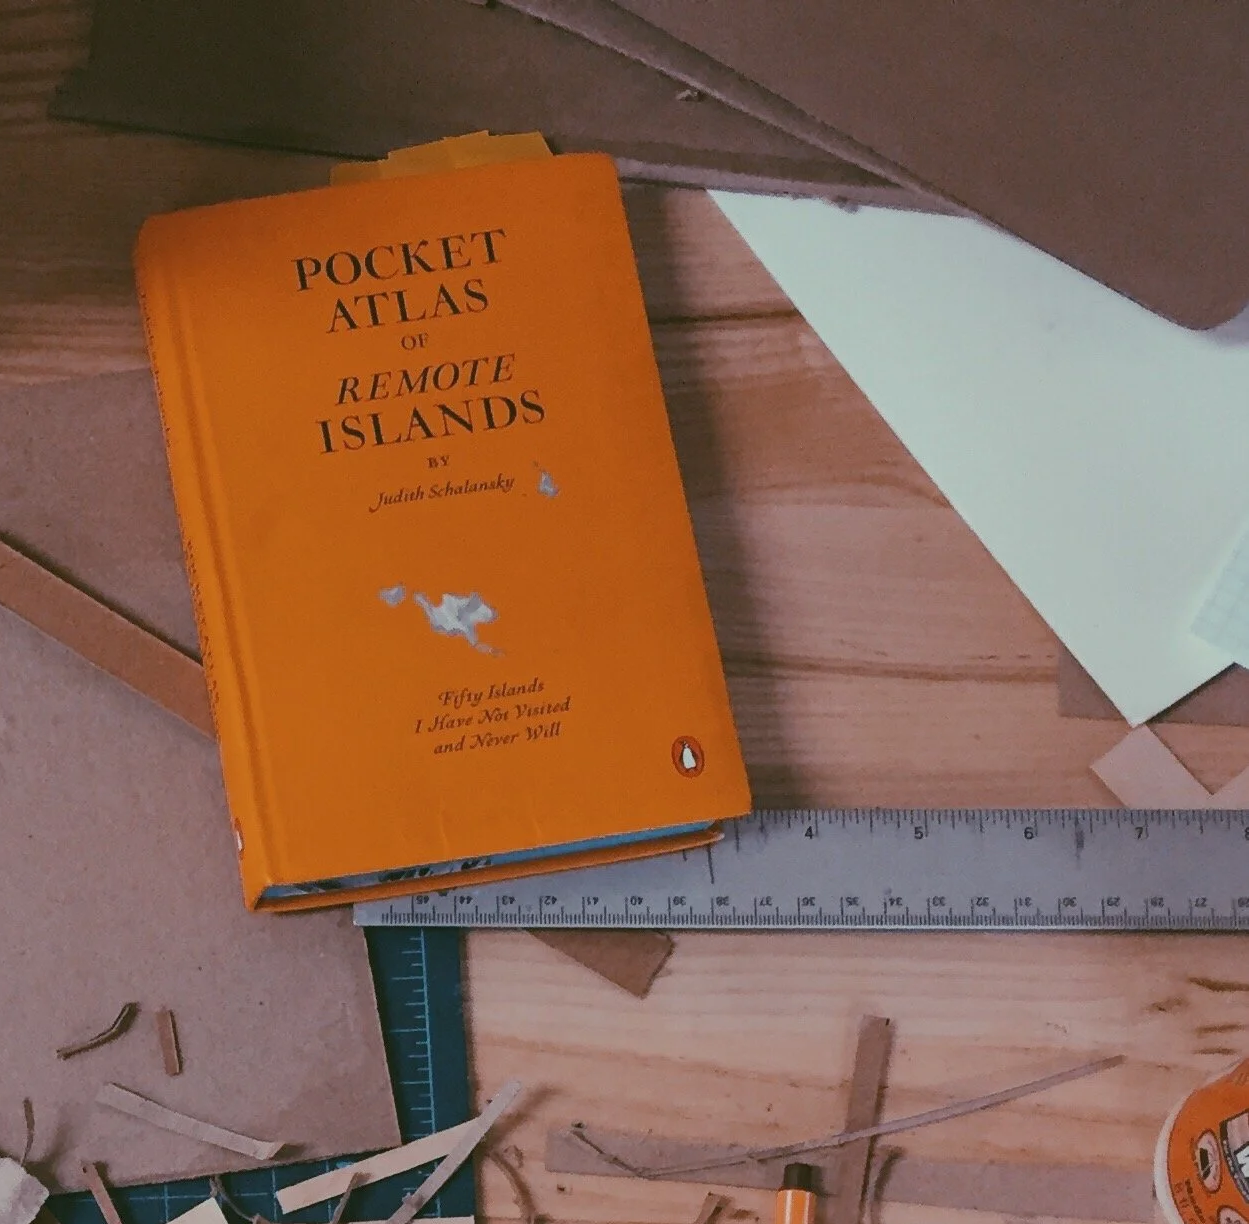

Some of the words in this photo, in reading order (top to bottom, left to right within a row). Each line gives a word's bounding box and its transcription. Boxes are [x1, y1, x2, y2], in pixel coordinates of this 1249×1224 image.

[291, 229, 507, 292] POCKET
[326, 278, 488, 333] ATLAS
[401, 333, 428, 350] OF
[334, 353, 515, 406] REMOTE
[315, 389, 545, 455] ISLANDS
[427, 455, 450, 469] BY
[368, 485, 424, 513] Judith
[428, 473, 515, 500] Schalansky
[438, 688, 483, 710] Fifty
[487, 677, 544, 700] Islands
[415, 719, 423, 733] I
[428, 713, 472, 732] Have
[478, 708, 509, 725] Not
[515, 695, 571, 719] Visited
[434, 735, 466, 754] and
[470, 732, 519, 750] Never
[526, 721, 561, 741] Will
[804, 828, 814, 840] 4
[914, 828, 924, 840] 5
[1024, 828, 1034, 840] 6
[1135, 828, 1144, 840] 7
